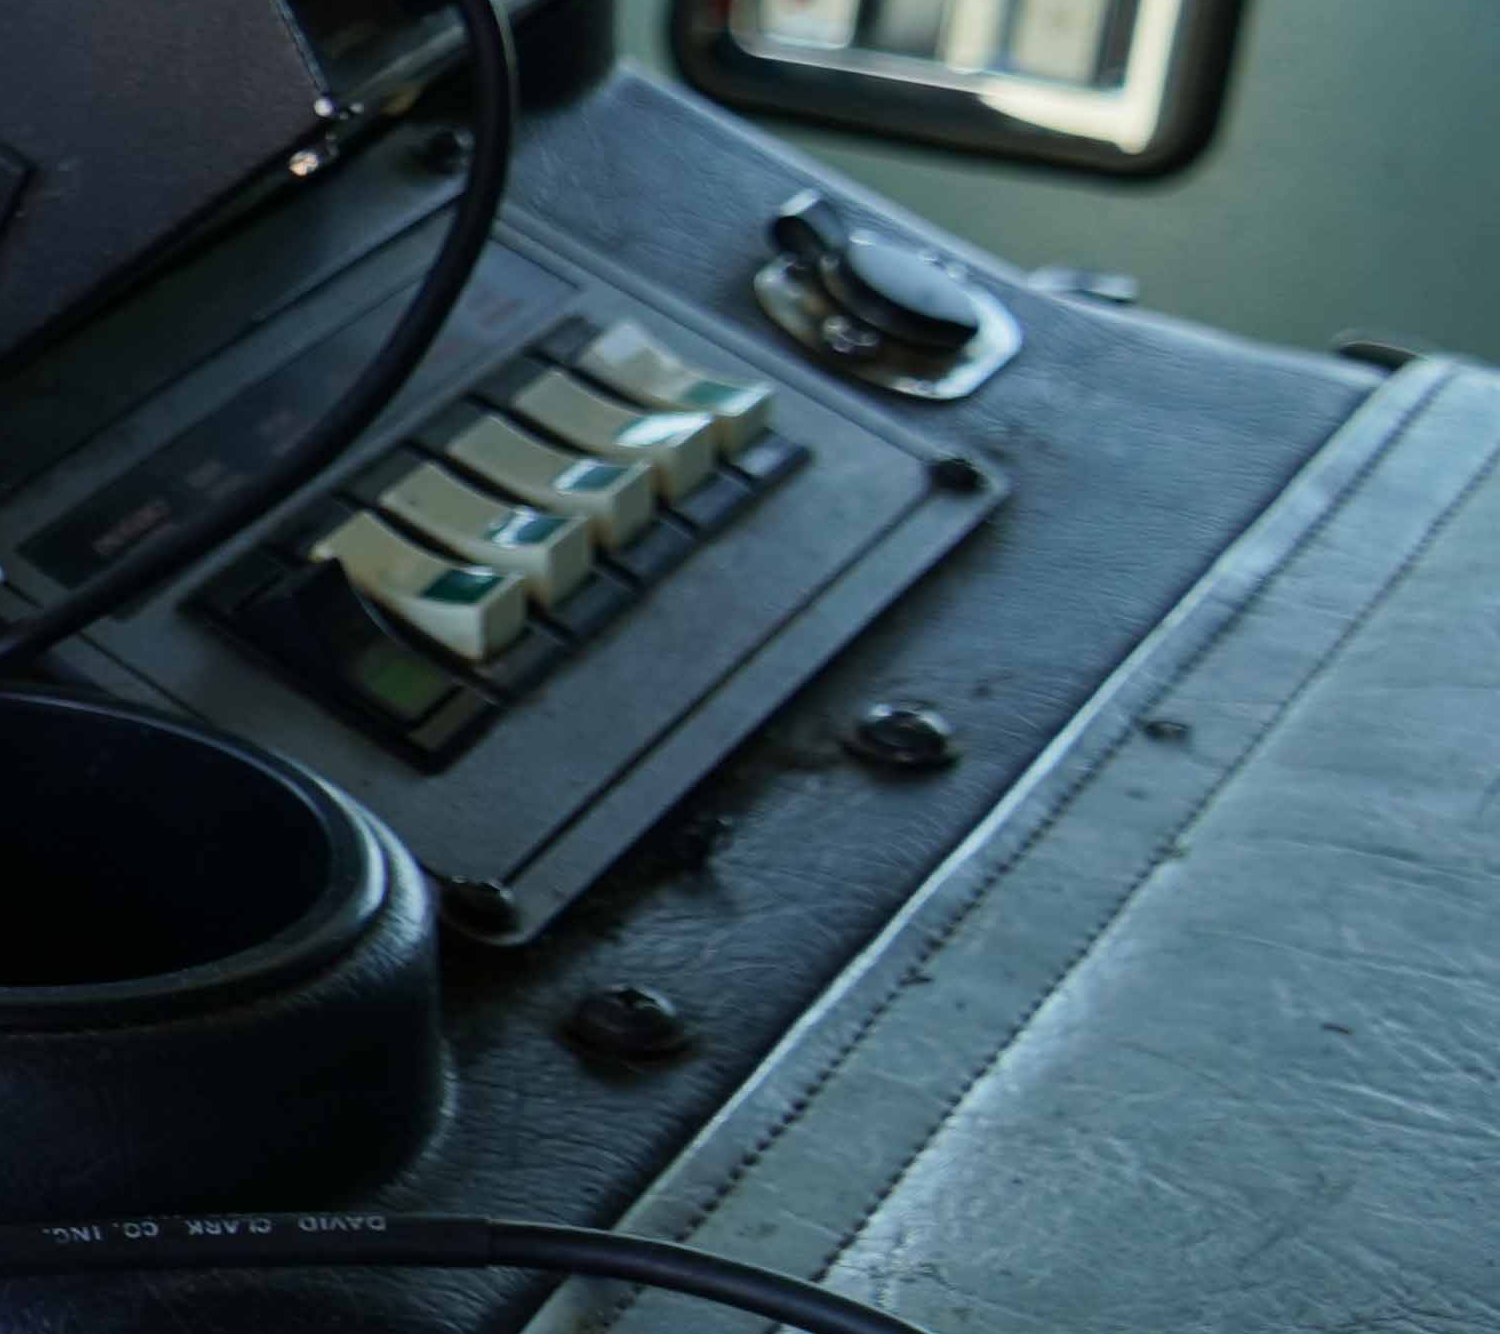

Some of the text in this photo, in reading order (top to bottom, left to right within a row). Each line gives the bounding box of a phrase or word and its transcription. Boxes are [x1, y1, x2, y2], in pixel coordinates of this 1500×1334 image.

[112, 1219, 161, 1241] CO.
[183, 1218, 274, 1237] CLARK
[297, 1214, 388, 1233] DAVID
